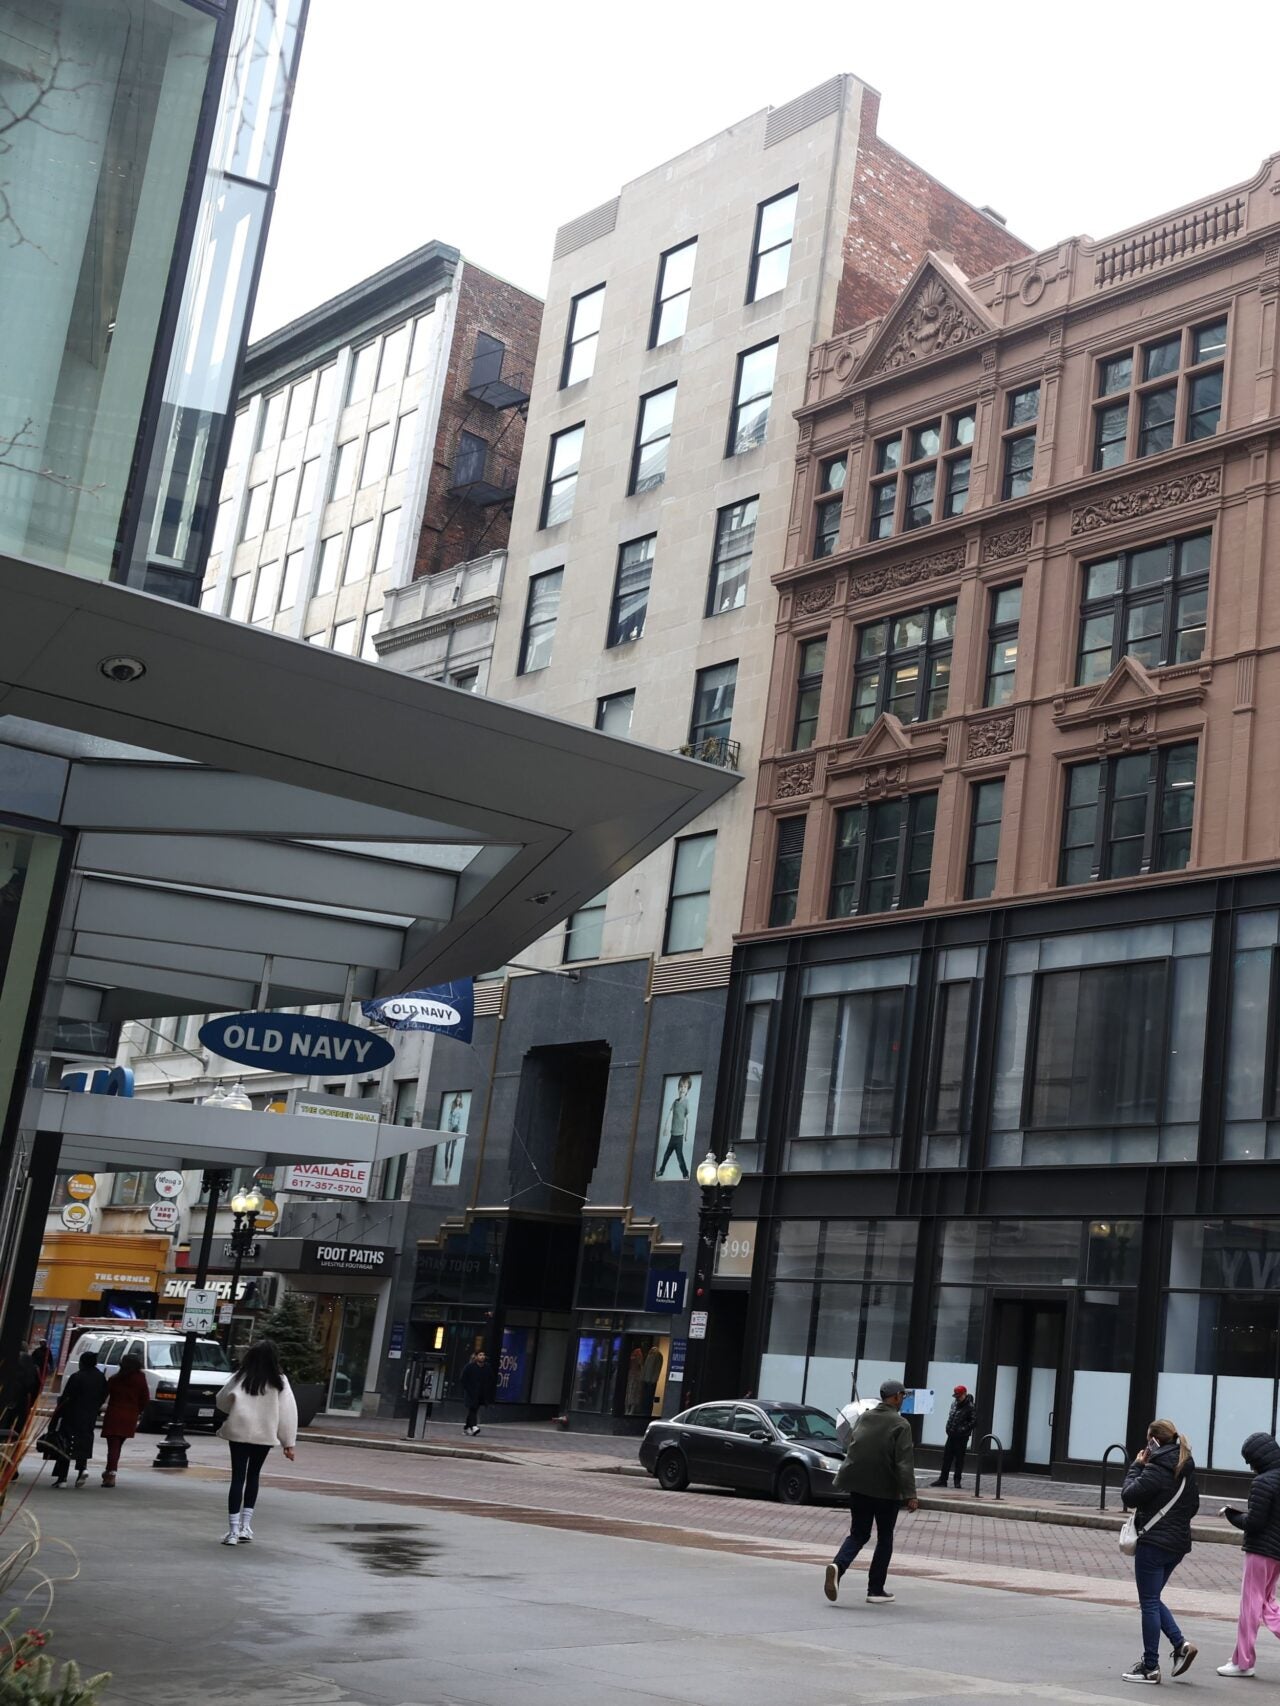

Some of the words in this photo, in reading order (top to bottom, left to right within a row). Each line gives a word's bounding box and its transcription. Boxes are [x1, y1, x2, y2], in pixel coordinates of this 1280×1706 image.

[392, 1003, 418, 1016] OLD
[420, 1005, 453, 1021] NAVY
[223, 1025, 284, 1053] OLD
[289, 1032, 373, 1063] NAVY
[301, 1105, 317, 1114] THE
[319, 1107, 353, 1119] CORNER
[355, 1112, 377, 1122] MALL
[293, 1163, 366, 1180] AVAILABLE
[291, 1179, 362, 1194] 617-357-5700
[317, 1246, 346, 1261] FOOT
[349, 1249, 385, 1264] PATHS
[721, 1240, 750, 1258] 399
[321, 1261, 345, 1269] LIFESTYLE
[95, 1273, 112, 1281] THE
[113, 1274, 151, 1283] CORNER
[656, 1280, 678, 1299] GAP
